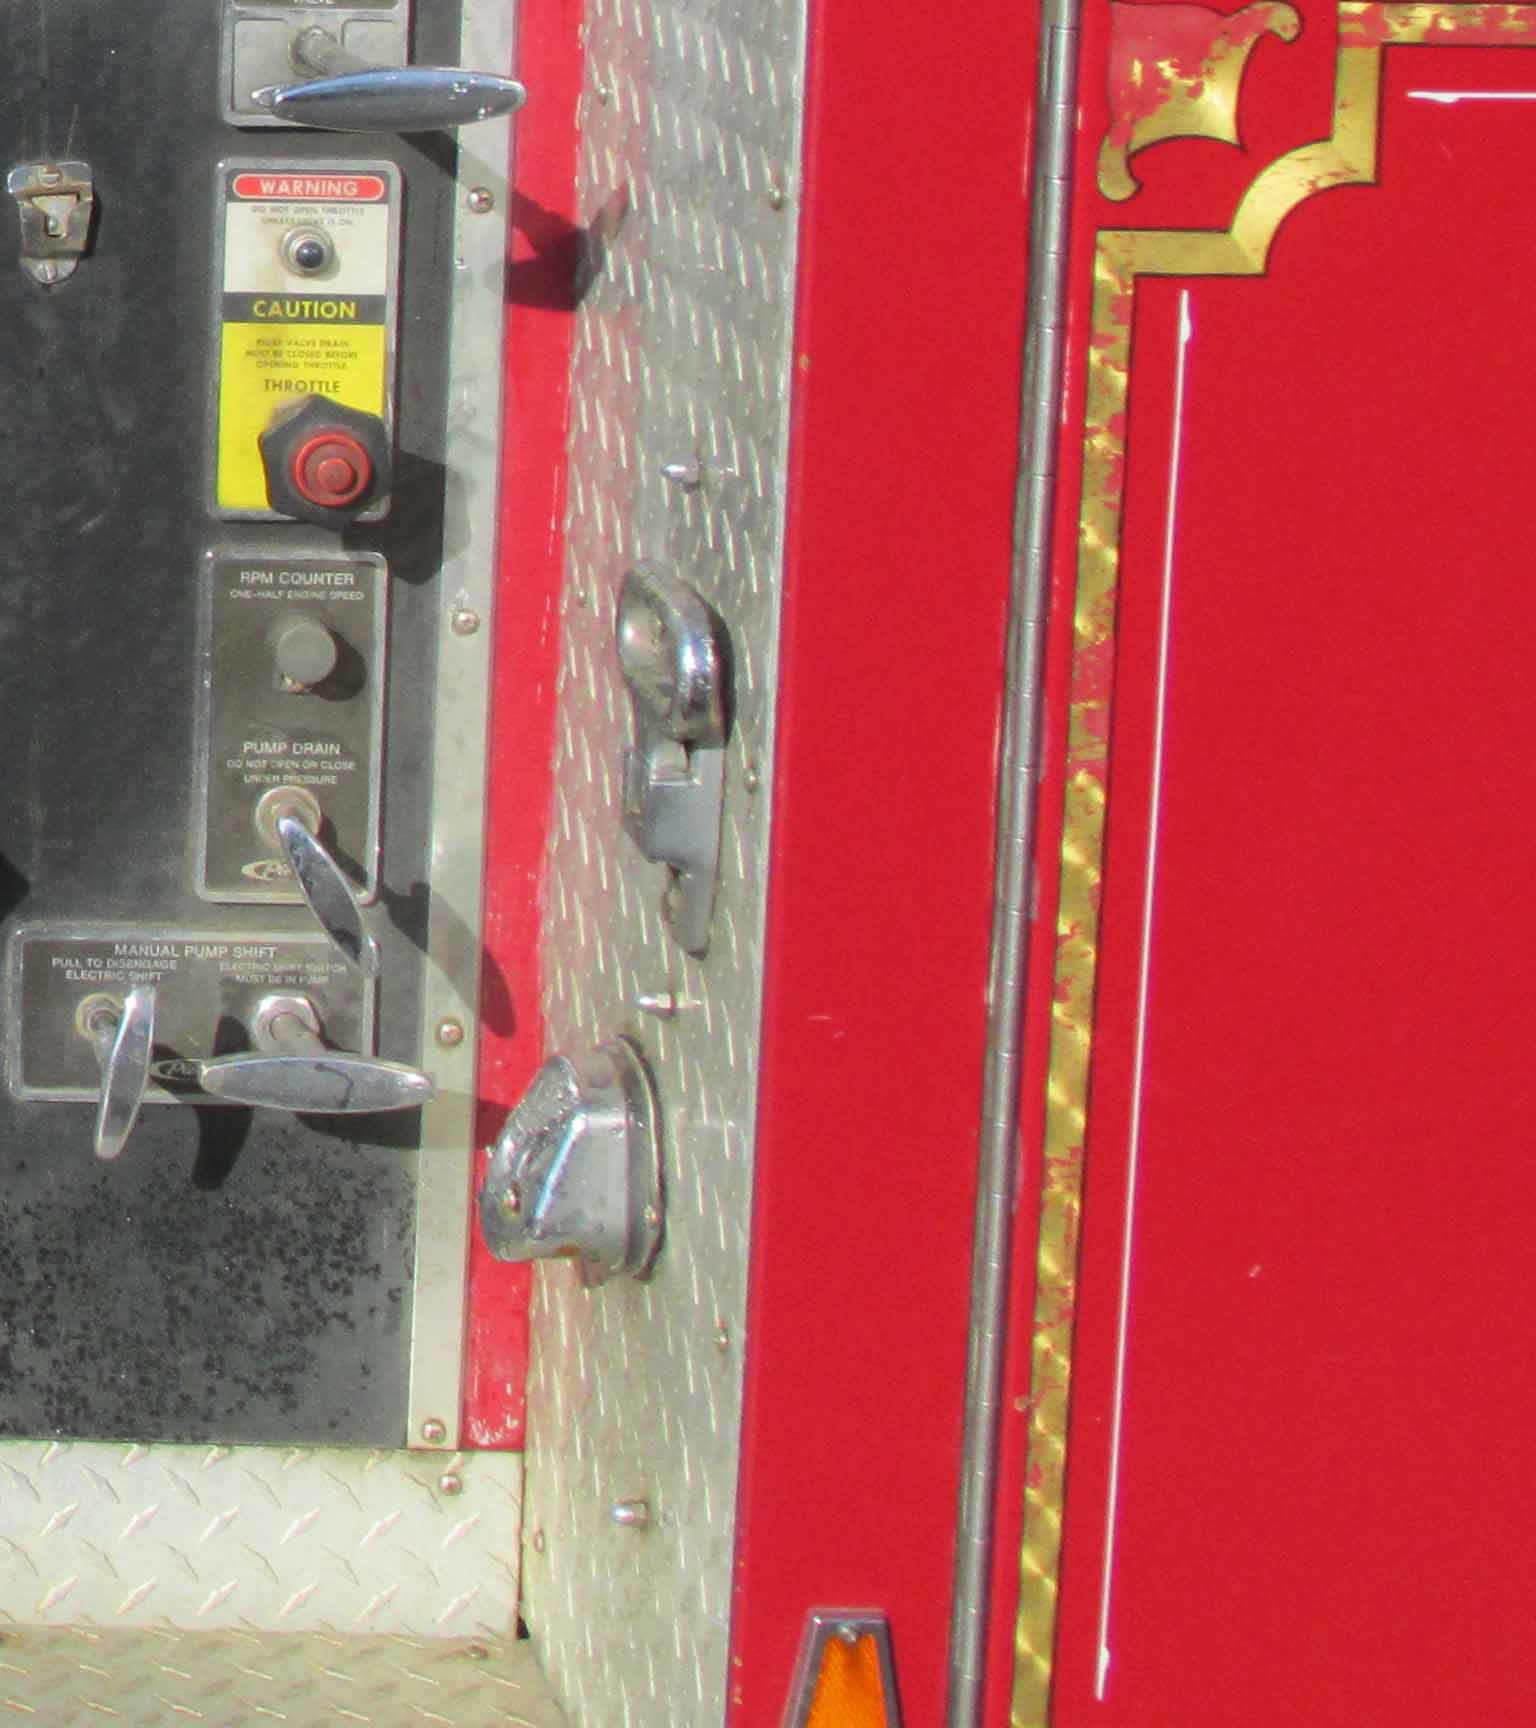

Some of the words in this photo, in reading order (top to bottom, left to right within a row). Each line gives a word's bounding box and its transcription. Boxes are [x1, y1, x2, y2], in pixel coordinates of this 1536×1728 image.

[260, 178, 359, 197] WARNING
[293, 206, 319, 215] OPEN
[252, 299, 357, 319] CAUTION
[264, 378, 342, 394] THROTTLE
[240, 572, 273, 586] RPM
[278, 572, 355, 586] COUNTER
[243, 743, 288, 756] PUMP
[292, 743, 341, 756] DRAIN
[245, 759, 268, 769] NOT
[301, 759, 319, 770] OR
[320, 759, 356, 770] CLOSE
[114, 944, 179, 958] MANUAL
[183, 946, 228, 959] PUMP
[232, 946, 277, 959] SHIFT
[51, 958, 83, 968] PULL
[87, 958, 103, 968] TO
